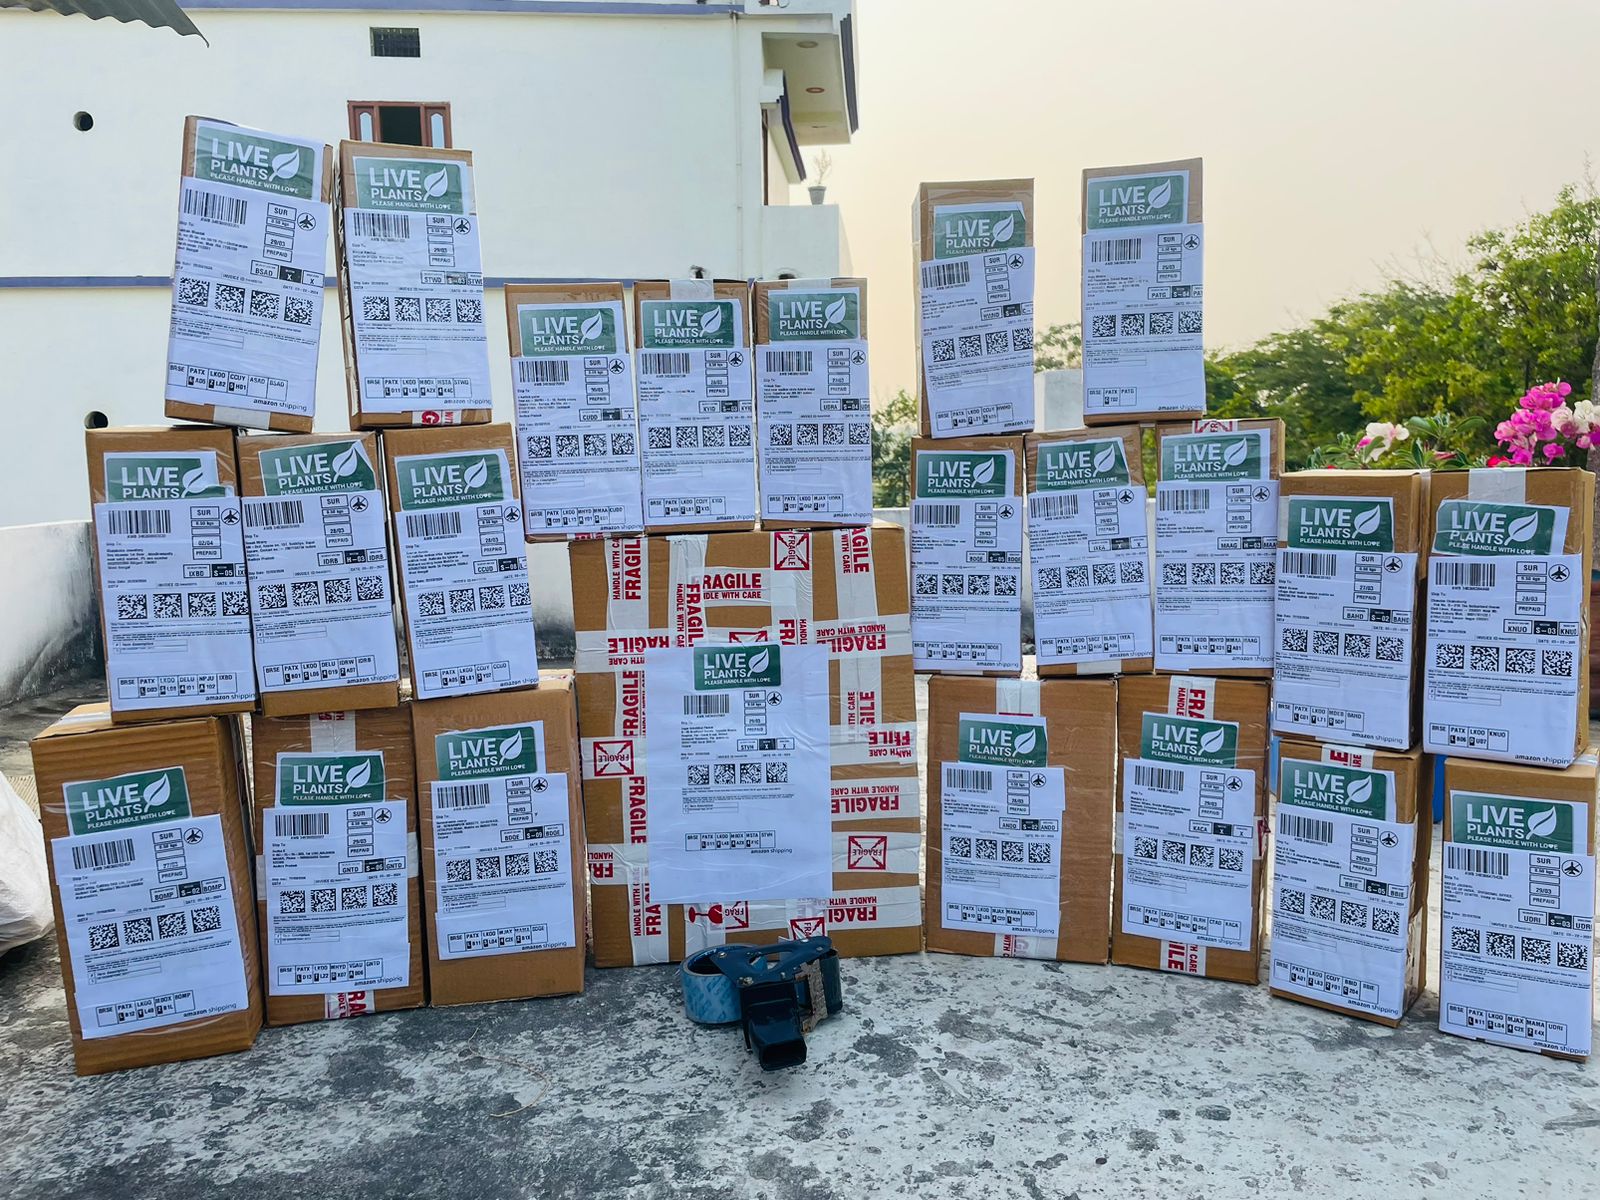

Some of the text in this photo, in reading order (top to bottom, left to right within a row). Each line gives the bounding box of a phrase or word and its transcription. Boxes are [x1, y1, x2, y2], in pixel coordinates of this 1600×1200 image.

[212, 138, 269, 167] LIVE
[211, 160, 268, 180] PLANTS
[369, 168, 421, 188] LIVE
[371, 189, 422, 201] PLANTS
[1099, 186, 1146, 206] LIVE
[274, 207, 288, 216] SUR
[1099, 205, 1145, 217] PLANTS
[946, 219, 990, 237] LIVE
[946, 238, 990, 248] PLANTS
[255, 268, 273, 276] BSAD
[780, 301, 822, 318] LIVE
[532, 317, 578, 334] LIVE
[654, 310, 698, 326] LIVE
[780, 320, 822, 329] PLANTS
[534, 335, 579, 345] PLANTS
[655, 328, 698, 337] PLANTS
[279, 402, 307, 411] shipping
[1046, 451, 1091, 470] LIVE
[1174, 443, 1221, 462] LIVE
[275, 453, 329, 476] LIVE
[928, 462, 971, 477] LIVE
[1175, 462, 1220, 472] PLANTS
[121, 467, 179, 486] LIVE
[279, 474, 332, 488] PLANTS
[410, 465, 461, 486] LIVE
[1048, 469, 1092, 480] PLANTS
[413, 484, 463, 498] PLANTS
[928, 478, 970, 488] PLANTS
[123, 488, 179, 498] PLANTS
[1301, 508, 1352, 527] LIVE
[1452, 511, 1506, 532] LIVE
[1300, 526, 1351, 538] PLANTS
[1450, 530, 1504, 545] PLANTS
[788, 535, 796, 565] FRAGILE
[841, 535, 851, 573] WITH CARE
[625, 537, 641, 600] FRAGIL
[703, 574, 761, 589] RAGILE
[676, 584, 684, 611] HANDLE
[817, 624, 886, 636] HANDLE WITH CARE
[608, 636, 669, 653] RAGILE
[704, 653, 746, 669] LIVE
[704, 669, 746, 679] PLANTS
[623, 671, 638, 738] FRAGILE
[1176, 688, 1186, 716] HANDLE
[970, 728, 1012, 746] LIVE
[1152, 723, 1199, 744] LIVE
[1376, 735, 1403, 744] shipping
[448, 738, 497, 759] LIVE
[869, 749, 887, 757] CARE
[969, 745, 1011, 756] PLANTS
[1152, 740, 1197, 755] PLANTS
[450, 756, 498, 770] PLANTS
[599, 754, 629, 762] FRAGILE
[293, 765, 343, 783] LIVE
[1294, 770, 1345, 793] LIVE
[82, 783, 140, 811] LIVE
[293, 784, 343, 794] PLANTS
[831, 785, 899, 795] HANDLE WITH CARE
[1294, 788, 1344, 804] PLANTS
[629, 777, 647, 845] FRAGILE
[831, 795, 899, 813] FRAGILE
[1294, 799, 1315, 807] PLEASE
[85, 804, 142, 822] PLANTS
[1467, 804, 1524, 827] LIVE
[87, 820, 112, 829] PLEASE
[1467, 823, 1524, 839] PLANTS
[1467, 835, 1491, 843] PLEASE
[1493, 838, 1519, 846] HANDLE
[830, 896, 877, 905] HANDLE WITH
[1189, 955, 1198, 973] CARE
[184, 1003, 236, 1017] amazon shipping
[1348, 999, 1398, 1015] amazon shipping
[1534, 1041, 1558, 1050] amazon
